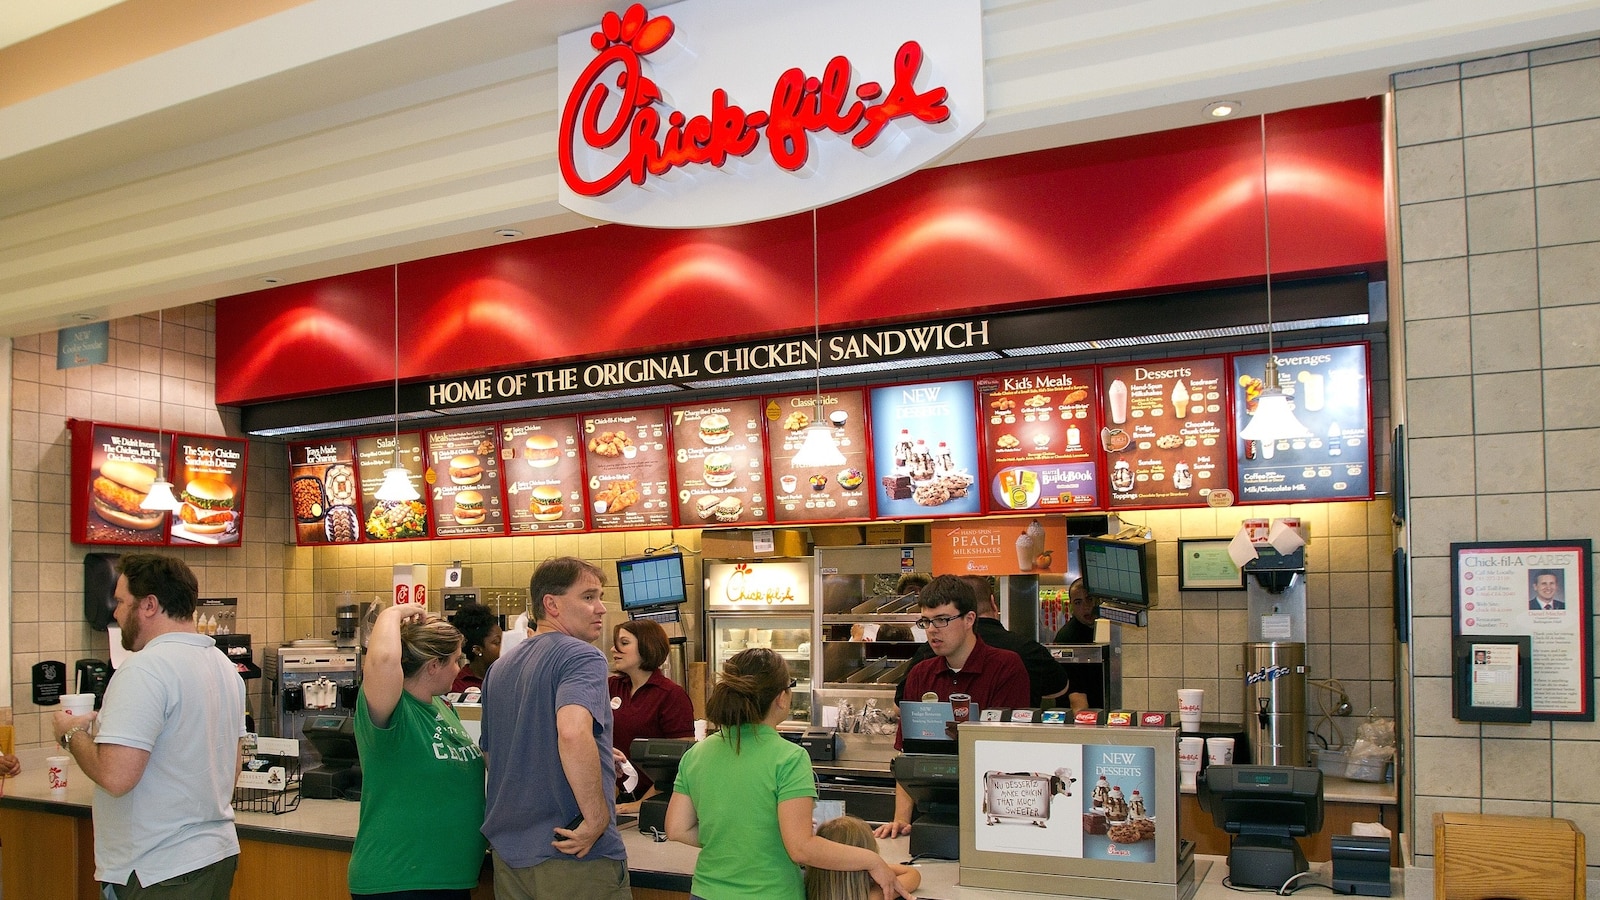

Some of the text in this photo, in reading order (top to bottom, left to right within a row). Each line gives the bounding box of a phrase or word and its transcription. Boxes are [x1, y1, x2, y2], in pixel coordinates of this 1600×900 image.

[558, 38, 951, 197] Chick-fil-A
[428, 319, 990, 406] HOME OF THE ORIGINAL CHICKEN SANDWICH
[1134, 368, 1192, 381] Desserts
[1004, 376, 1032, 391] Kid's
[1036, 374, 1072, 388] Meals
[902, 386, 942, 404] NEW
[790, 396, 838, 408] Classic ides
[673, 411, 684, 425] 7
[896, 406, 950, 419] DESSERTS
[585, 419, 595, 433] 5
[430, 432, 449, 443] Meals
[504, 428, 513, 441] 3
[111, 436, 155, 448] We Didn't Invent
[377, 437, 399, 449] Salad
[103, 444, 115, 452] The
[139, 448, 150, 456] Just
[150, 449, 161, 458] The
[183, 445, 240, 459] The Spicy Chicken
[305, 445, 337, 456] Trays Made
[677, 448, 688, 463] 8
[107, 453, 156, 464] Chicken Sandwich
[185, 456, 237, 469] Sandwich Deluxe
[432, 451, 439, 464] 1
[508, 482, 519, 495] 4
[590, 476, 600, 489] 6
[433, 487, 442, 500] 2
[679, 490, 691, 504] 9
[952, 535, 1001, 546] PEACH
[953, 547, 1001, 555] MILKSHAKES
[1465, 554, 1572, 567] Chick-fil-A CARES
[726, 570, 794, 604] Chick-fil-A
[432, 742, 484, 762] CELTIC
[1102, 752, 1136, 765] NEW
[1096, 766, 1141, 777] DESSERTS
[994, 780, 1038, 790] NU DESSERTZ
[1021, 789, 1042, 797] CHIKIN
[1017, 797, 1036, 806] MUCH
[1006, 807, 1039, 817] SWEETER
